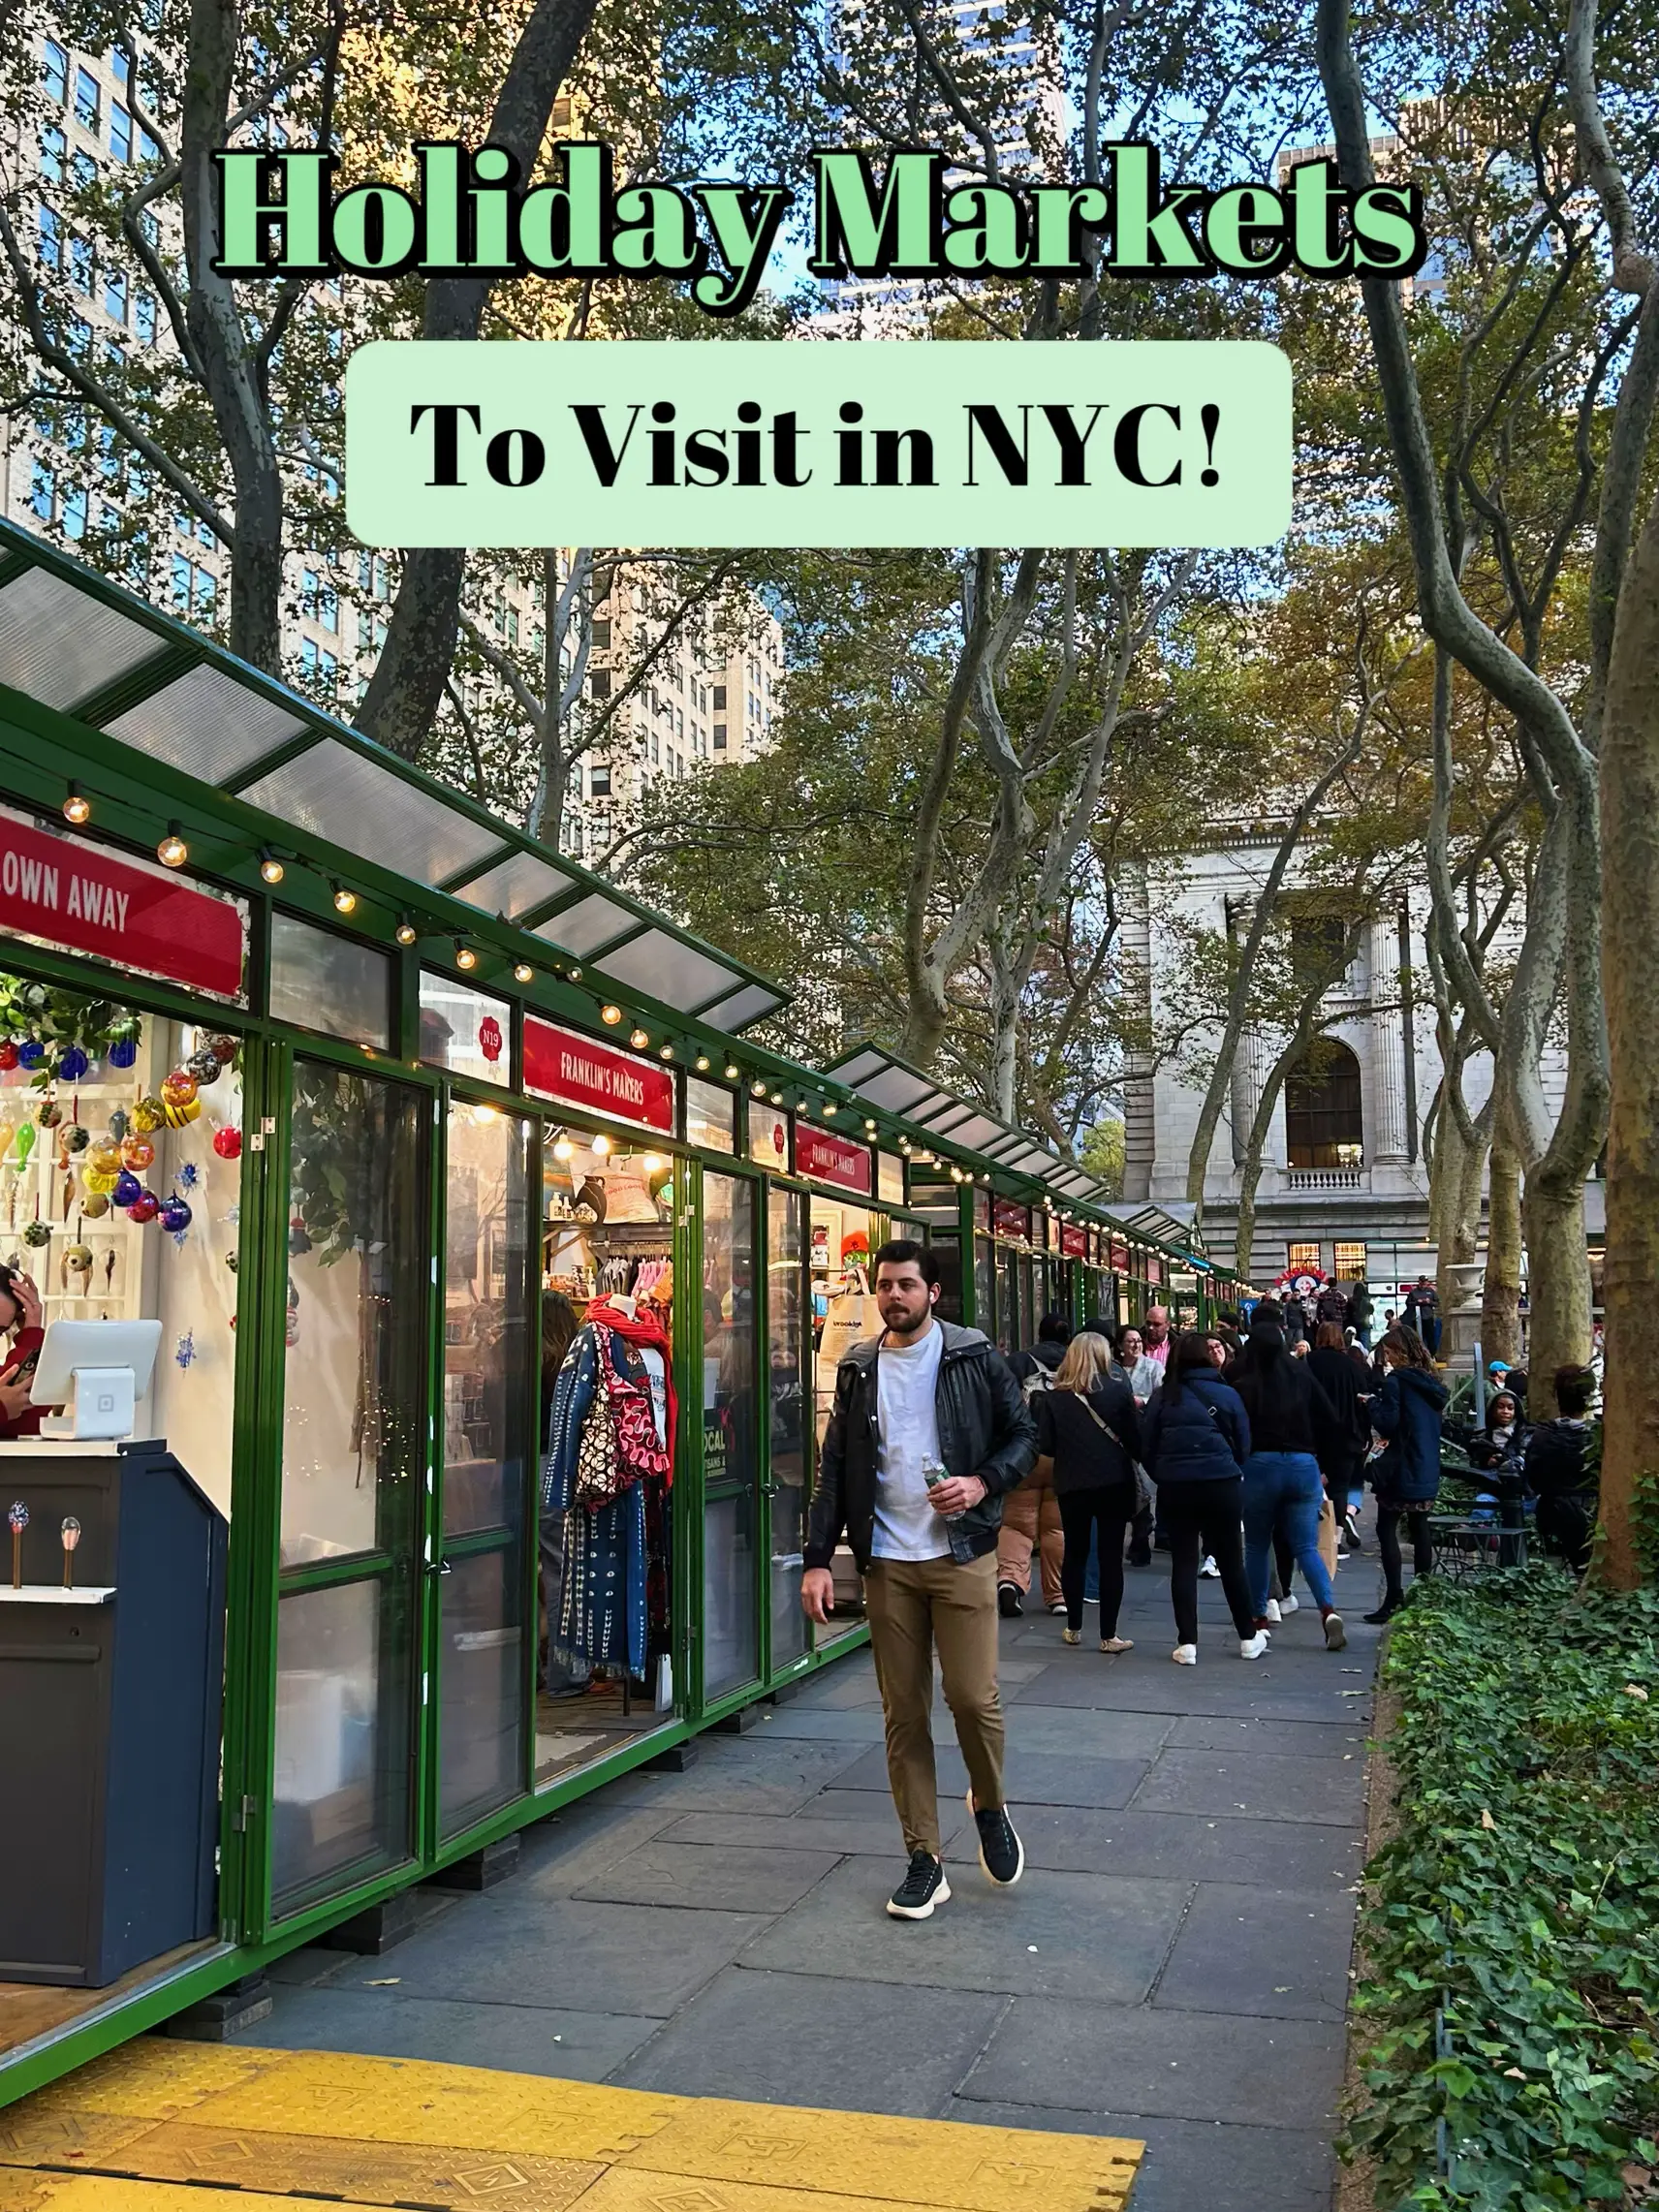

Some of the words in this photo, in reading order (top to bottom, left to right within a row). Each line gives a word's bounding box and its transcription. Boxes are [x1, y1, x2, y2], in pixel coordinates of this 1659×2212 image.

[0, 851, 58, 911] OWN
[67, 874, 130, 933] AWAY
[483, 1029, 499, 1047] N19
[561, 1050, 611, 1095] FRANKLIN'S
[612, 1069, 644, 1106] MAKERS
